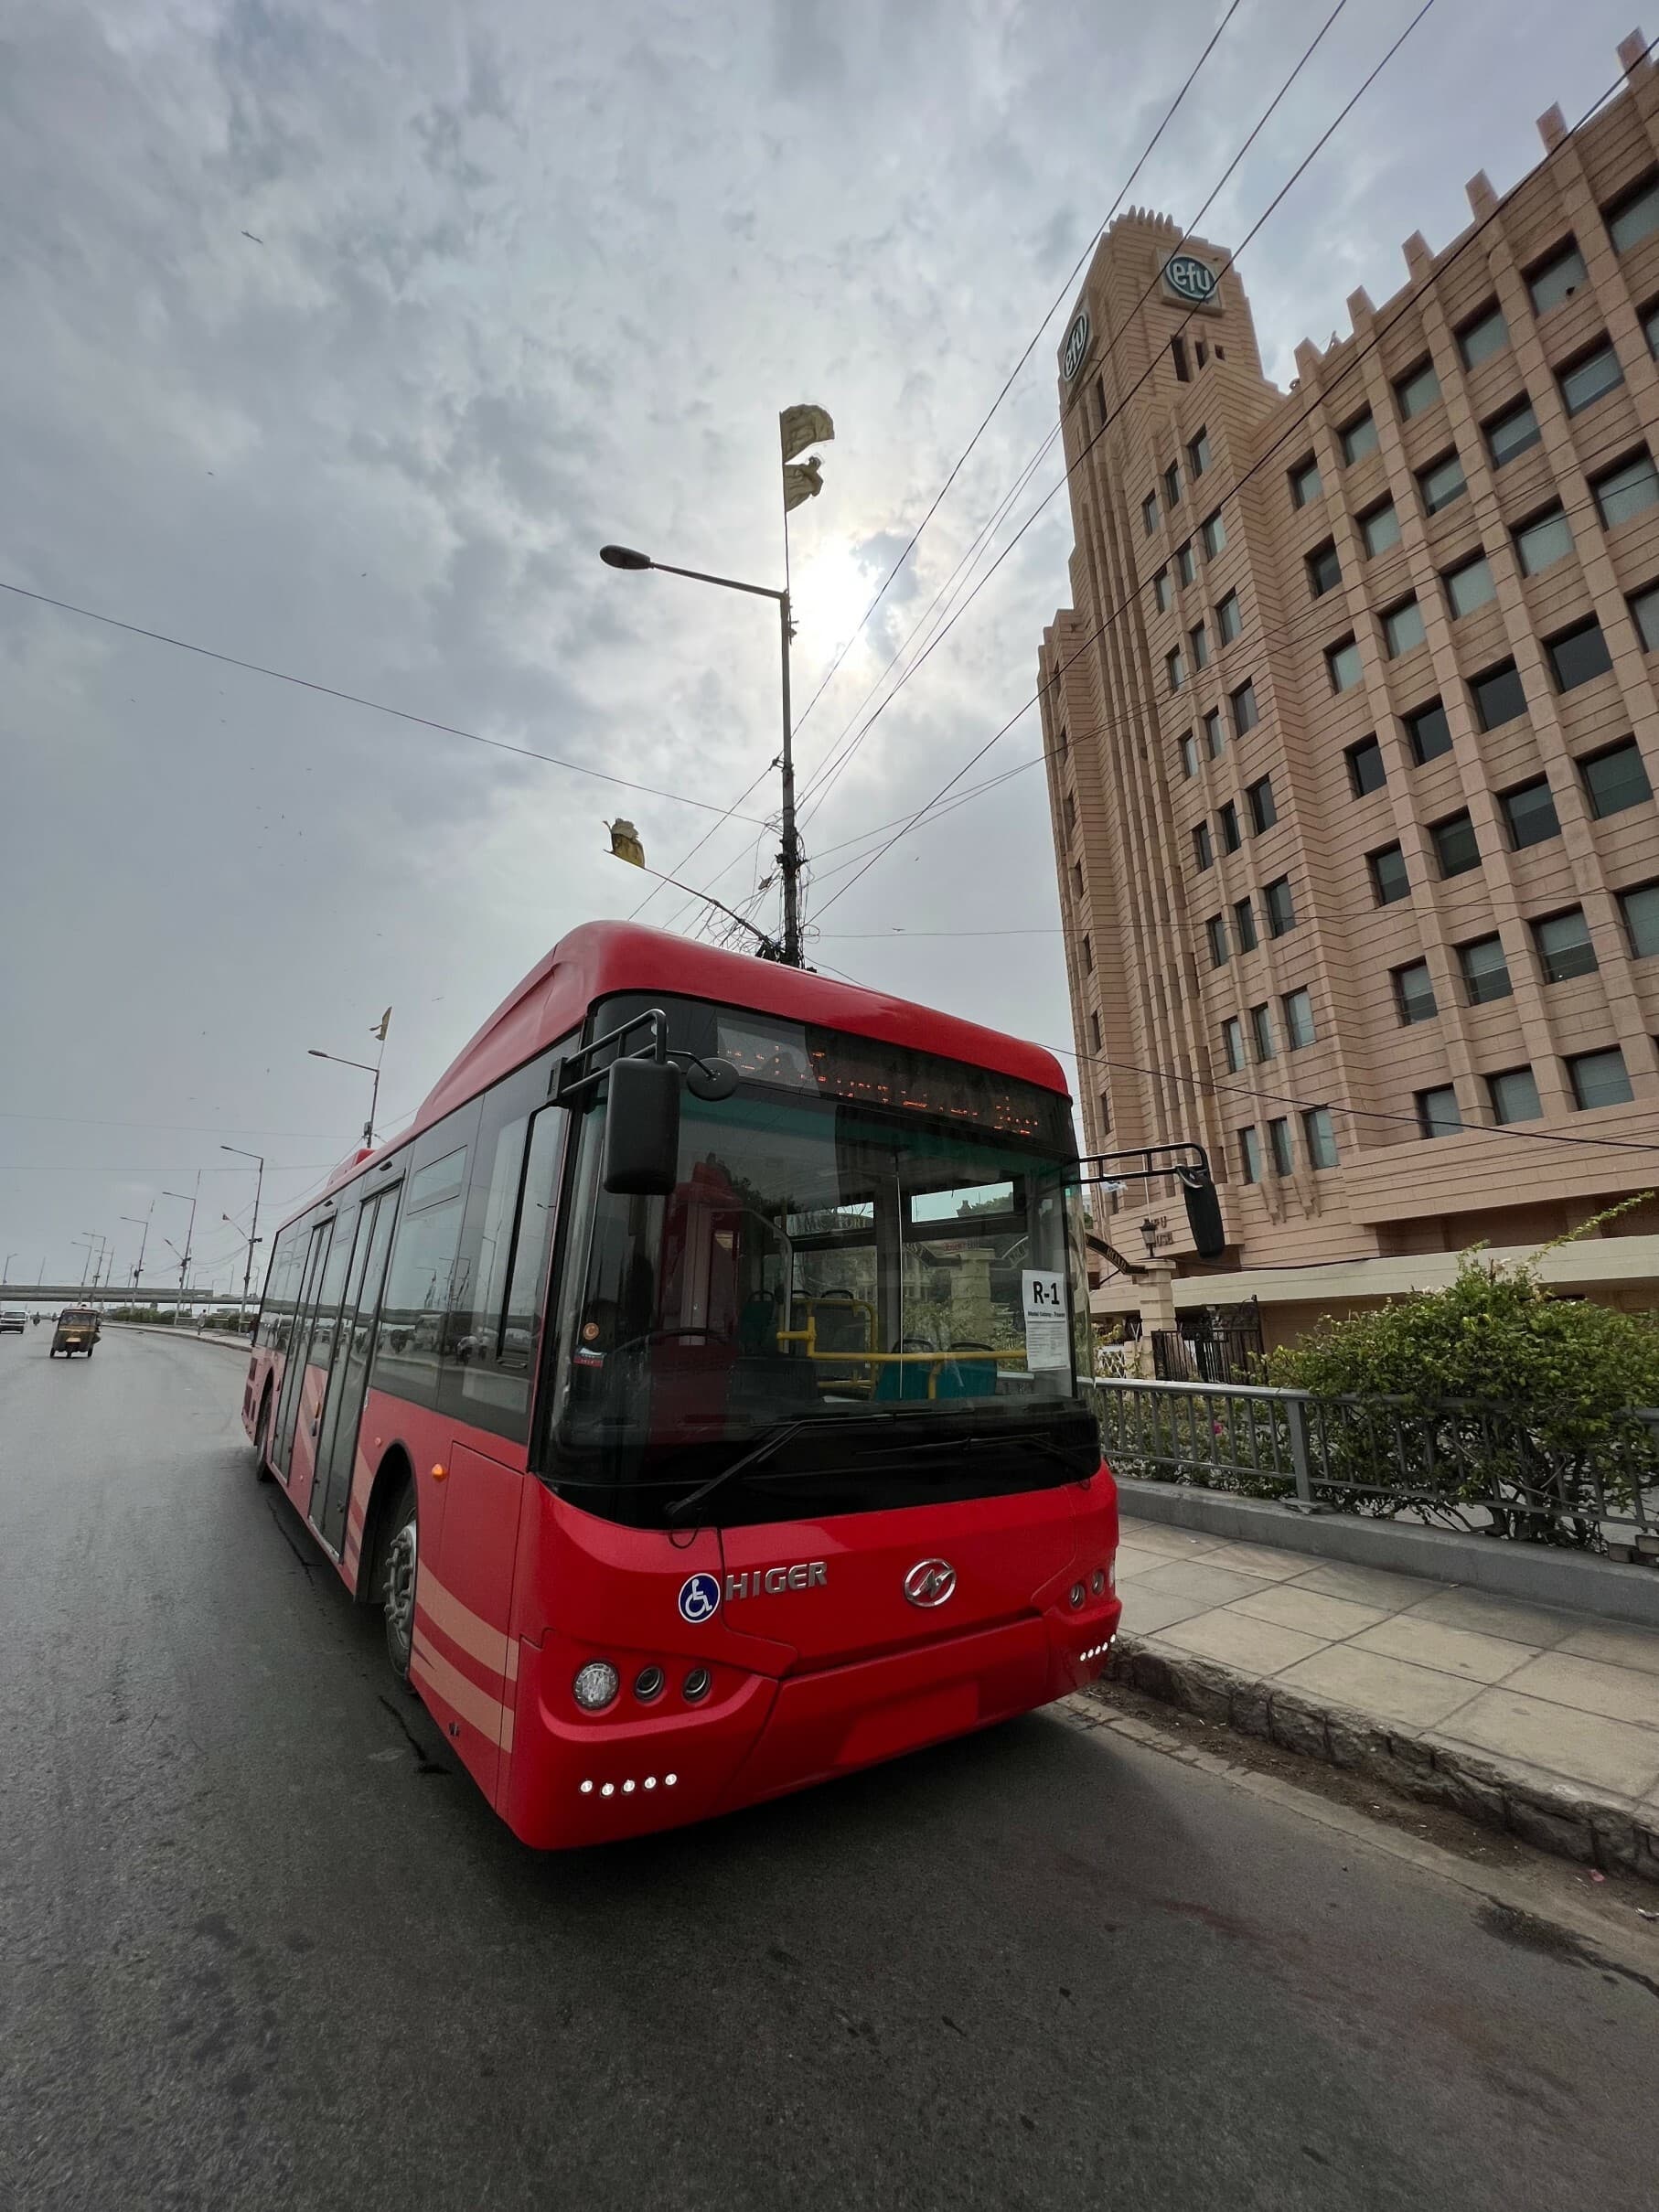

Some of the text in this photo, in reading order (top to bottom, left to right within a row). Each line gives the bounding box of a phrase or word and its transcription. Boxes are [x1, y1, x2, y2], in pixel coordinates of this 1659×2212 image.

[1172, 262, 1211, 292] efu
[1065, 317, 1084, 377] efu
[1033, 1280, 1060, 1305] R-1
[725, 1561, 828, 1602] HIGER
